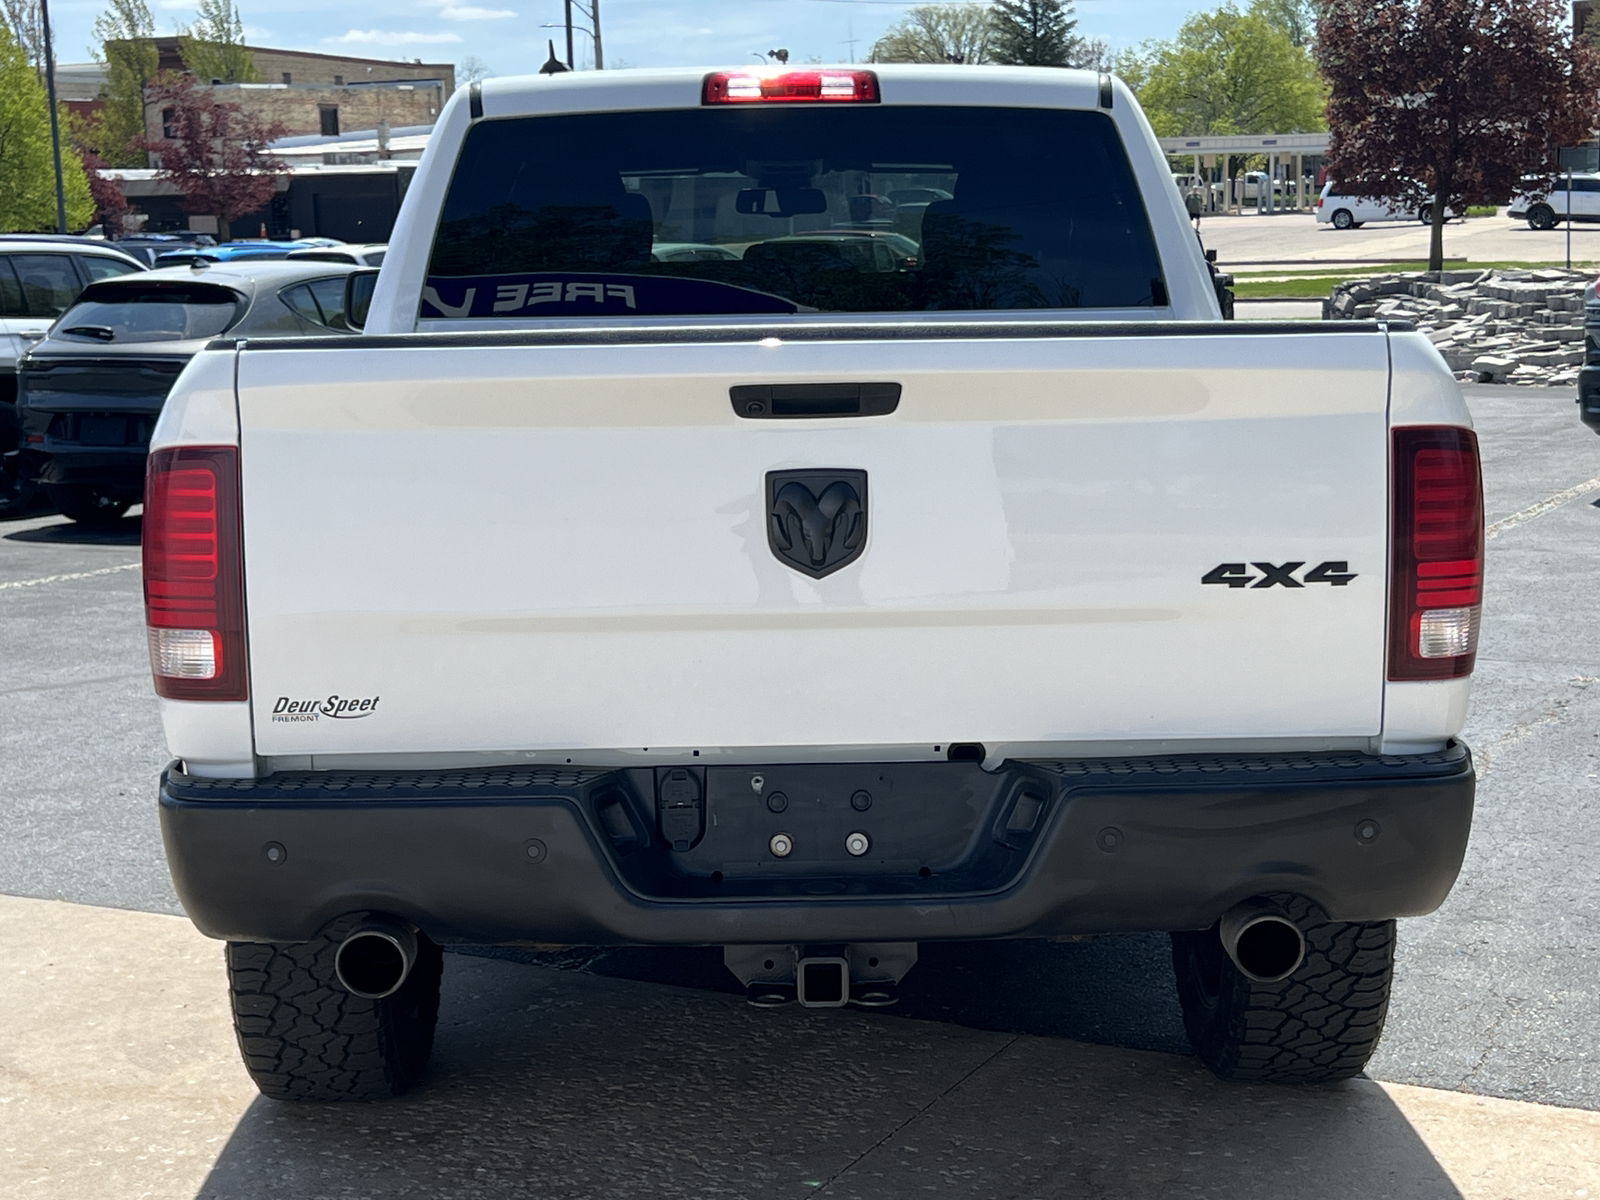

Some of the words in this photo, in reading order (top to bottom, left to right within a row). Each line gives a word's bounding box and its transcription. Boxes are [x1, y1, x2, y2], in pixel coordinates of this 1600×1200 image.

[1201, 560, 1359, 588] 4X4
[272, 697, 320, 713] Deur
[323, 695, 380, 717] Speet
